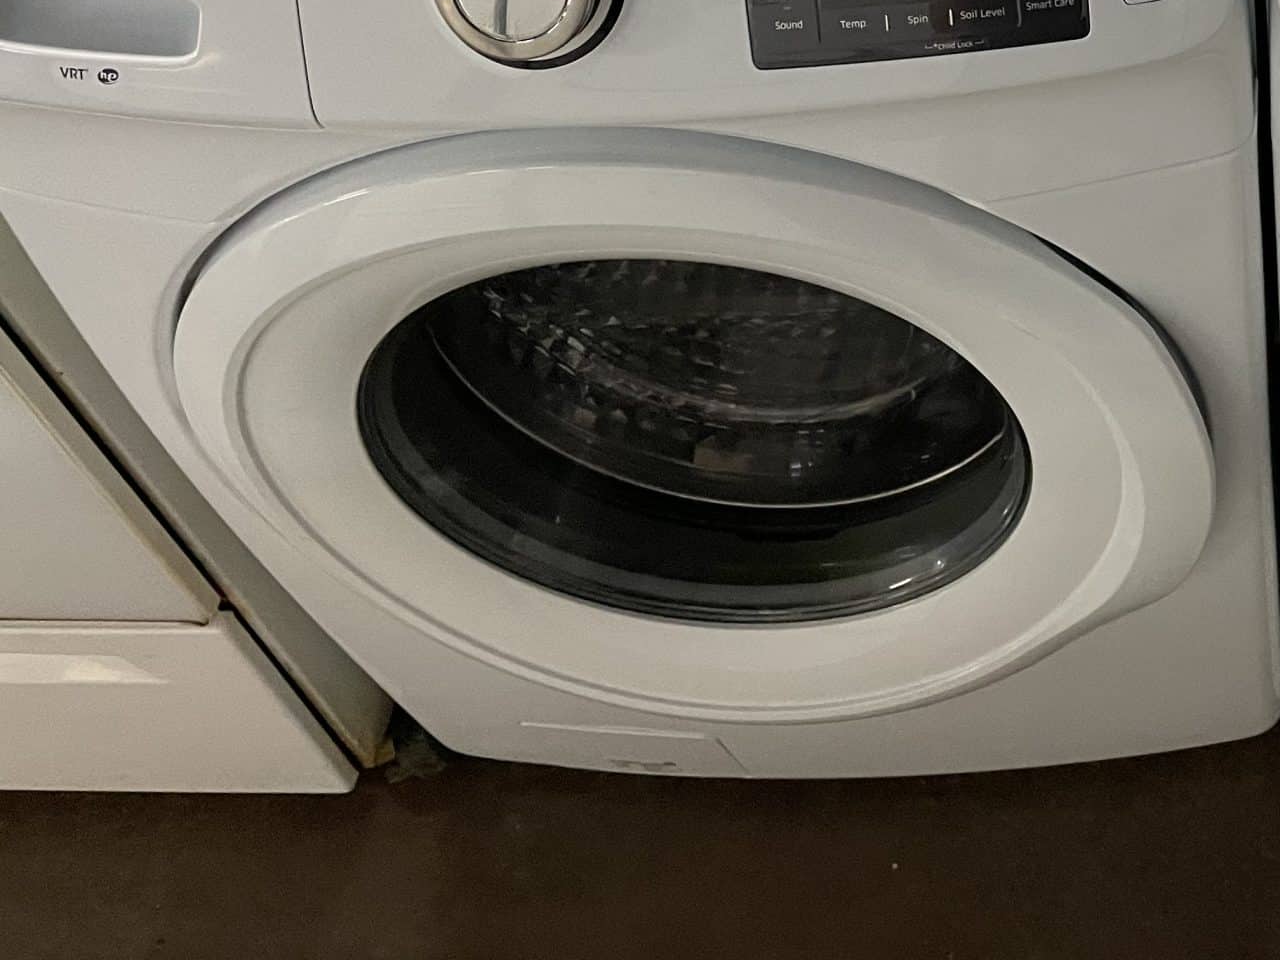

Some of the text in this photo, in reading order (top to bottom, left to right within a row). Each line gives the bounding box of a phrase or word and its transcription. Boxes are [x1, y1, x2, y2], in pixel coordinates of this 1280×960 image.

[1025, 0, 1052, 12] Smart
[907, 14, 929, 26] Spin
[959, 7, 1006, 21] Soil Level
[775, 19, 803, 30] Sound
[839, 19, 867, 31] Temp
